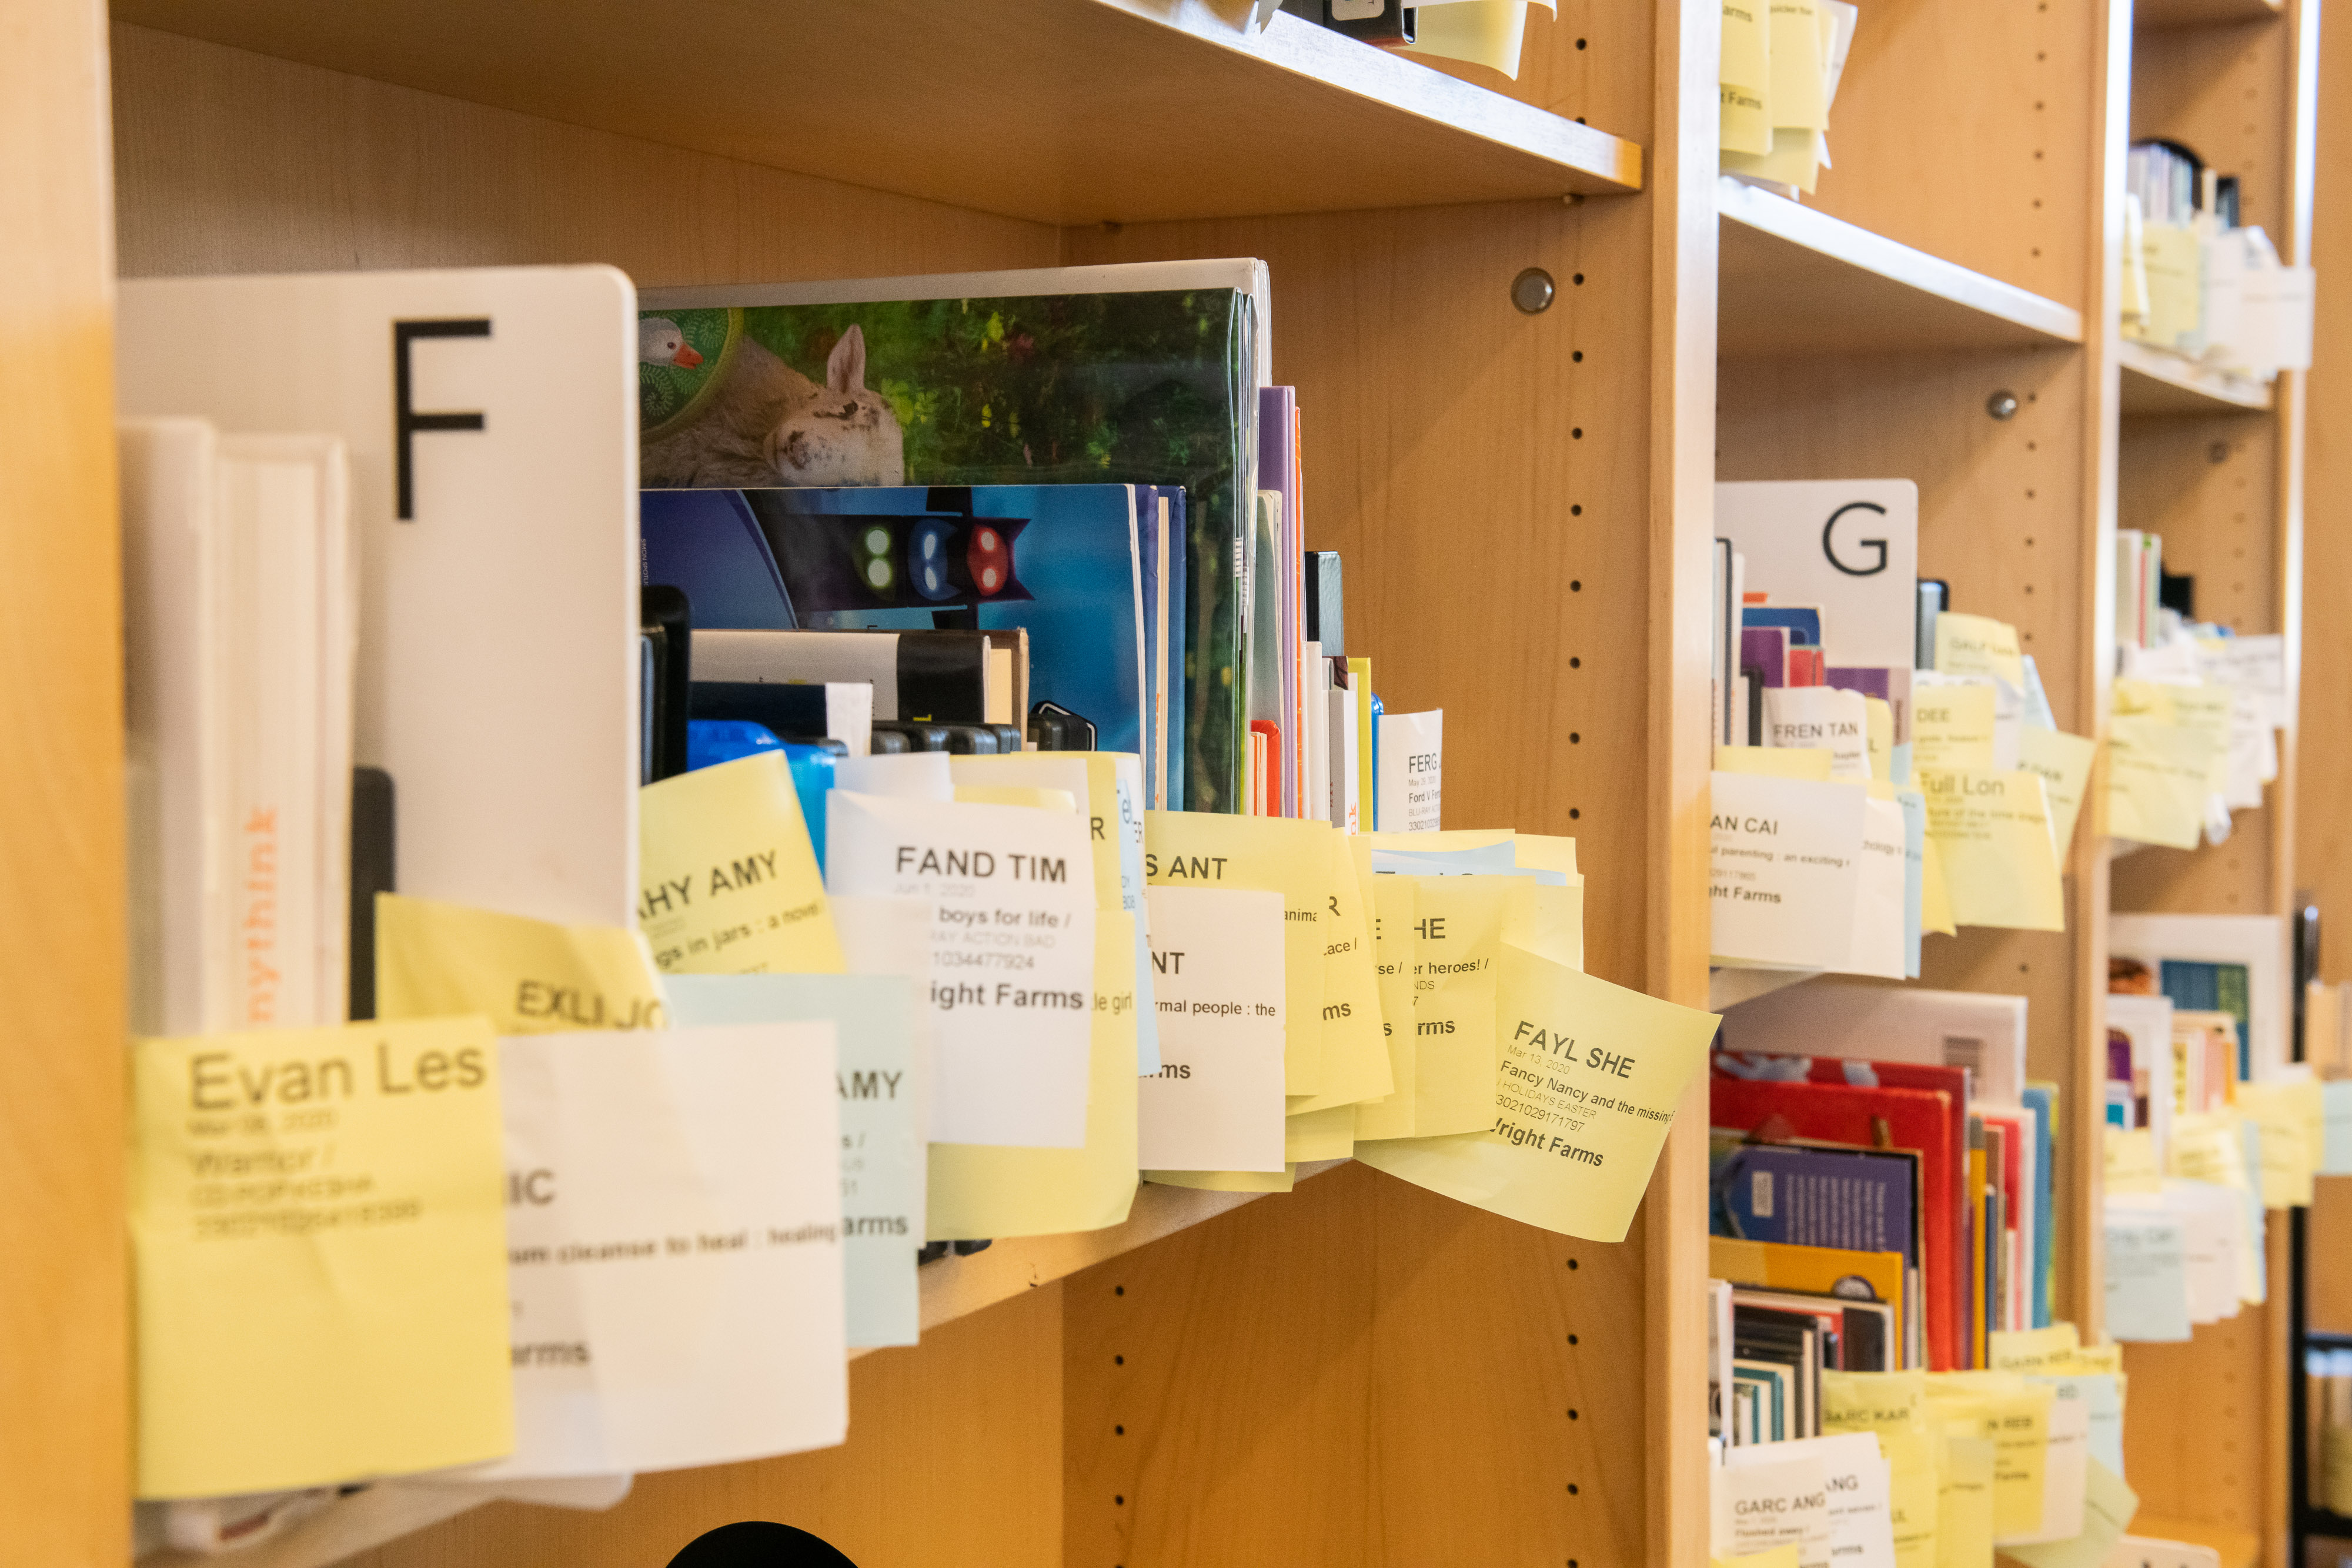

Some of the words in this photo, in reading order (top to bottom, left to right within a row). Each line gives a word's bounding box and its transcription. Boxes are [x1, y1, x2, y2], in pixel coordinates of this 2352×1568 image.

[392, 318, 493, 521] F
[1822, 501, 1887, 576] G
[1409, 753, 1437, 773] FERG
[1409, 792, 1425, 804] Ford
[1745, 817, 1779, 835] CAI
[896, 846, 995, 878] FAND
[1007, 852, 1067, 883] TIM
[1168, 855, 1228, 880] ANT
[637, 874, 691, 920] HY
[709, 848, 776, 897] AMY
[1733, 887, 1782, 904] Farms
[243, 803, 280, 1023] nythink
[939, 906, 988, 929] boys
[995, 908, 1022, 927] for
[1028, 910, 1059, 928] life
[1428, 958, 1480, 975] heroes!
[929, 981, 986, 1010] ight
[995, 983, 1084, 1010] Farms
[1192, 1001, 1242, 1018] people
[1255, 1002, 1276, 1017] the
[1506, 1044, 1528, 1059] Mar
[1545, 1059, 1571, 1075] 2020
[1513, 1020, 1578, 1062] FAYL
[1586, 1047, 1636, 1079] SHE
[188, 1049, 354, 1112] Evan
[375, 1038, 487, 1095] Les
[1499, 1059, 1545, 1088] Fancy
[1546, 1077, 1589, 1103] Nancy
[1590, 1093, 1616, 1110] and
[1618, 1099, 1635, 1116] the
[1496, 1094, 1585, 1133] 3021029171797
[1502, 1080, 1556, 1106] HOLIDAYS
[1556, 1099, 1598, 1120] EASTER
[1548, 1136, 1605, 1167] Farms
[843, 1215, 909, 1236] arms
[1734, 1497, 1786, 1515] GARC
